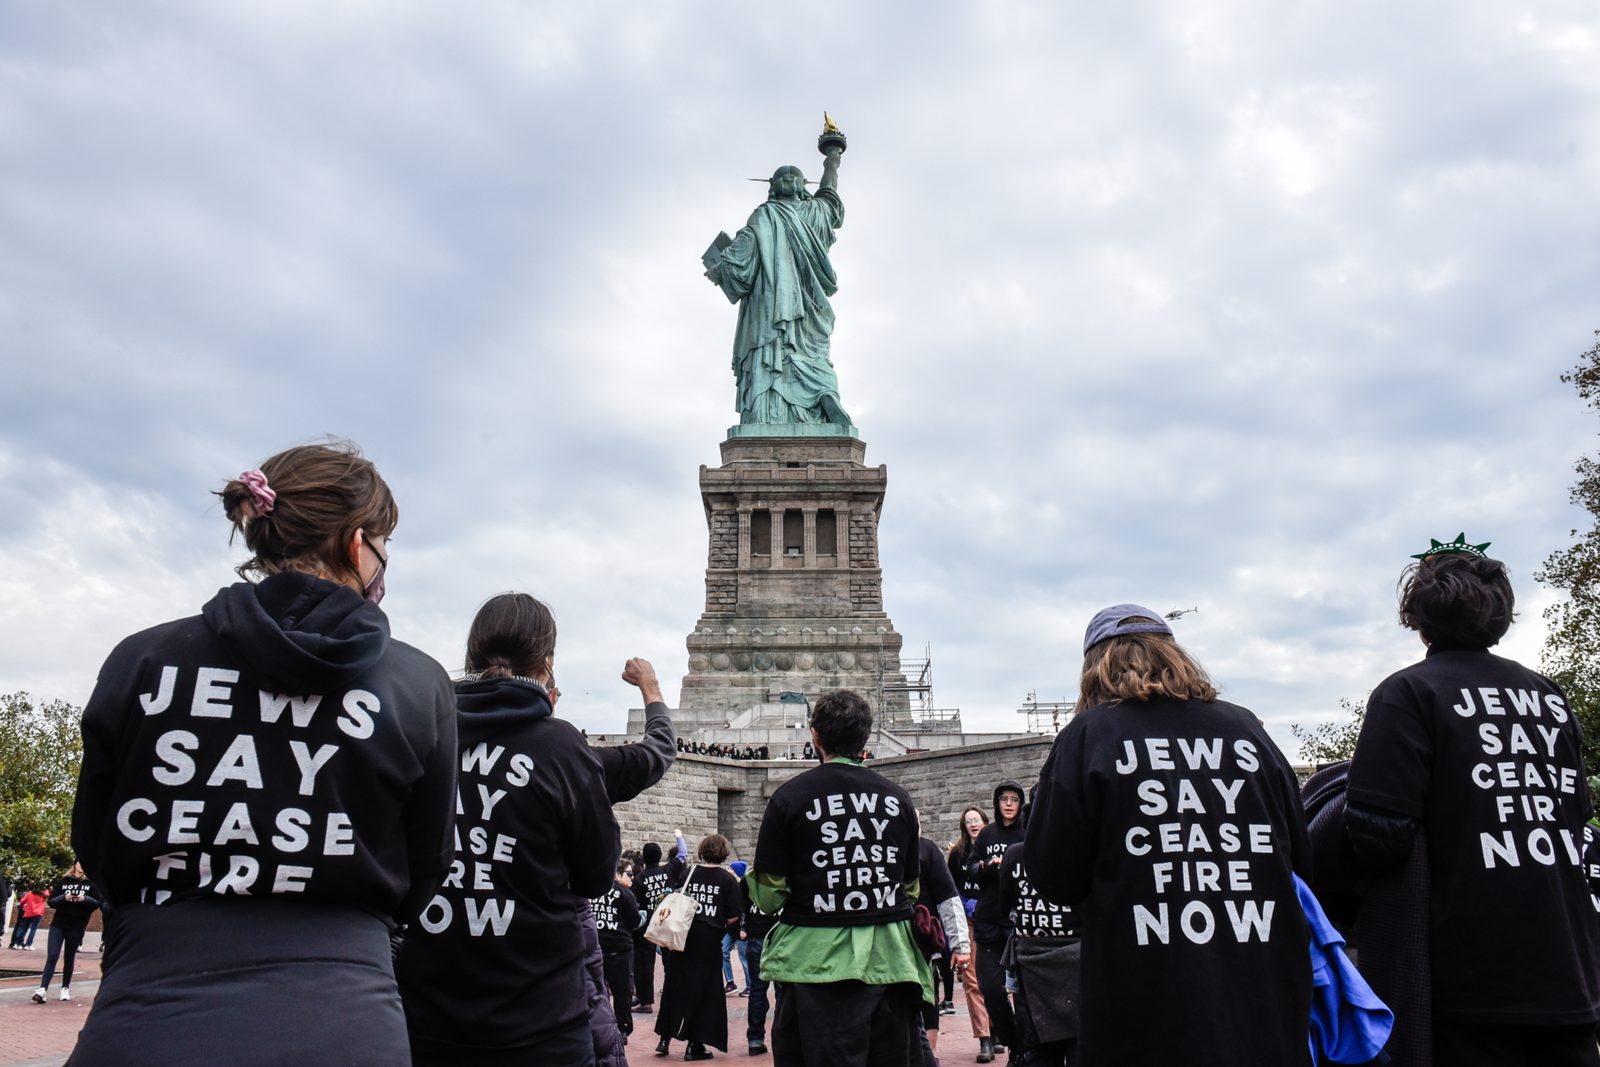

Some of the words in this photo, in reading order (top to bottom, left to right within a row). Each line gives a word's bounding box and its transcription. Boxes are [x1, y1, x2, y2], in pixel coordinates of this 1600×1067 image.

[139, 666, 381, 740] JEWS
[1453, 687, 1568, 724] JEWS
[1478, 722, 1561, 757] SAY
[152, 729, 340, 796] SAY
[462, 742, 534, 787] WS
[1115, 738, 1260, 775] JEWS
[1471, 761, 1577, 794] CEASE
[805, 793, 900, 820] JEWS
[1137, 778, 1245, 816] SAY
[1496, 795, 1561, 823] FIR
[116, 797, 356, 856] CEASE
[820, 818, 889, 843] SAY
[1125, 822, 1274, 856] CEASE
[812, 844, 899, 868] CEASE
[986, 843, 1008, 855] NOT
[152, 851, 315, 896] FIRE
[643, 873, 668, 885] JEWS
[647, 880, 666, 891] SAY
[827, 866, 890, 889] FIRE
[1152, 860, 1253, 893] FIRE
[695, 903, 717, 917] OW
[813, 883, 900, 913] NOW
[419, 894, 515, 937] OW
[593, 912, 613, 922] IRE
[596, 920, 618, 931] OW
[1021, 913, 1063, 928] FIRE
[1133, 900, 1276, 946] NOW
